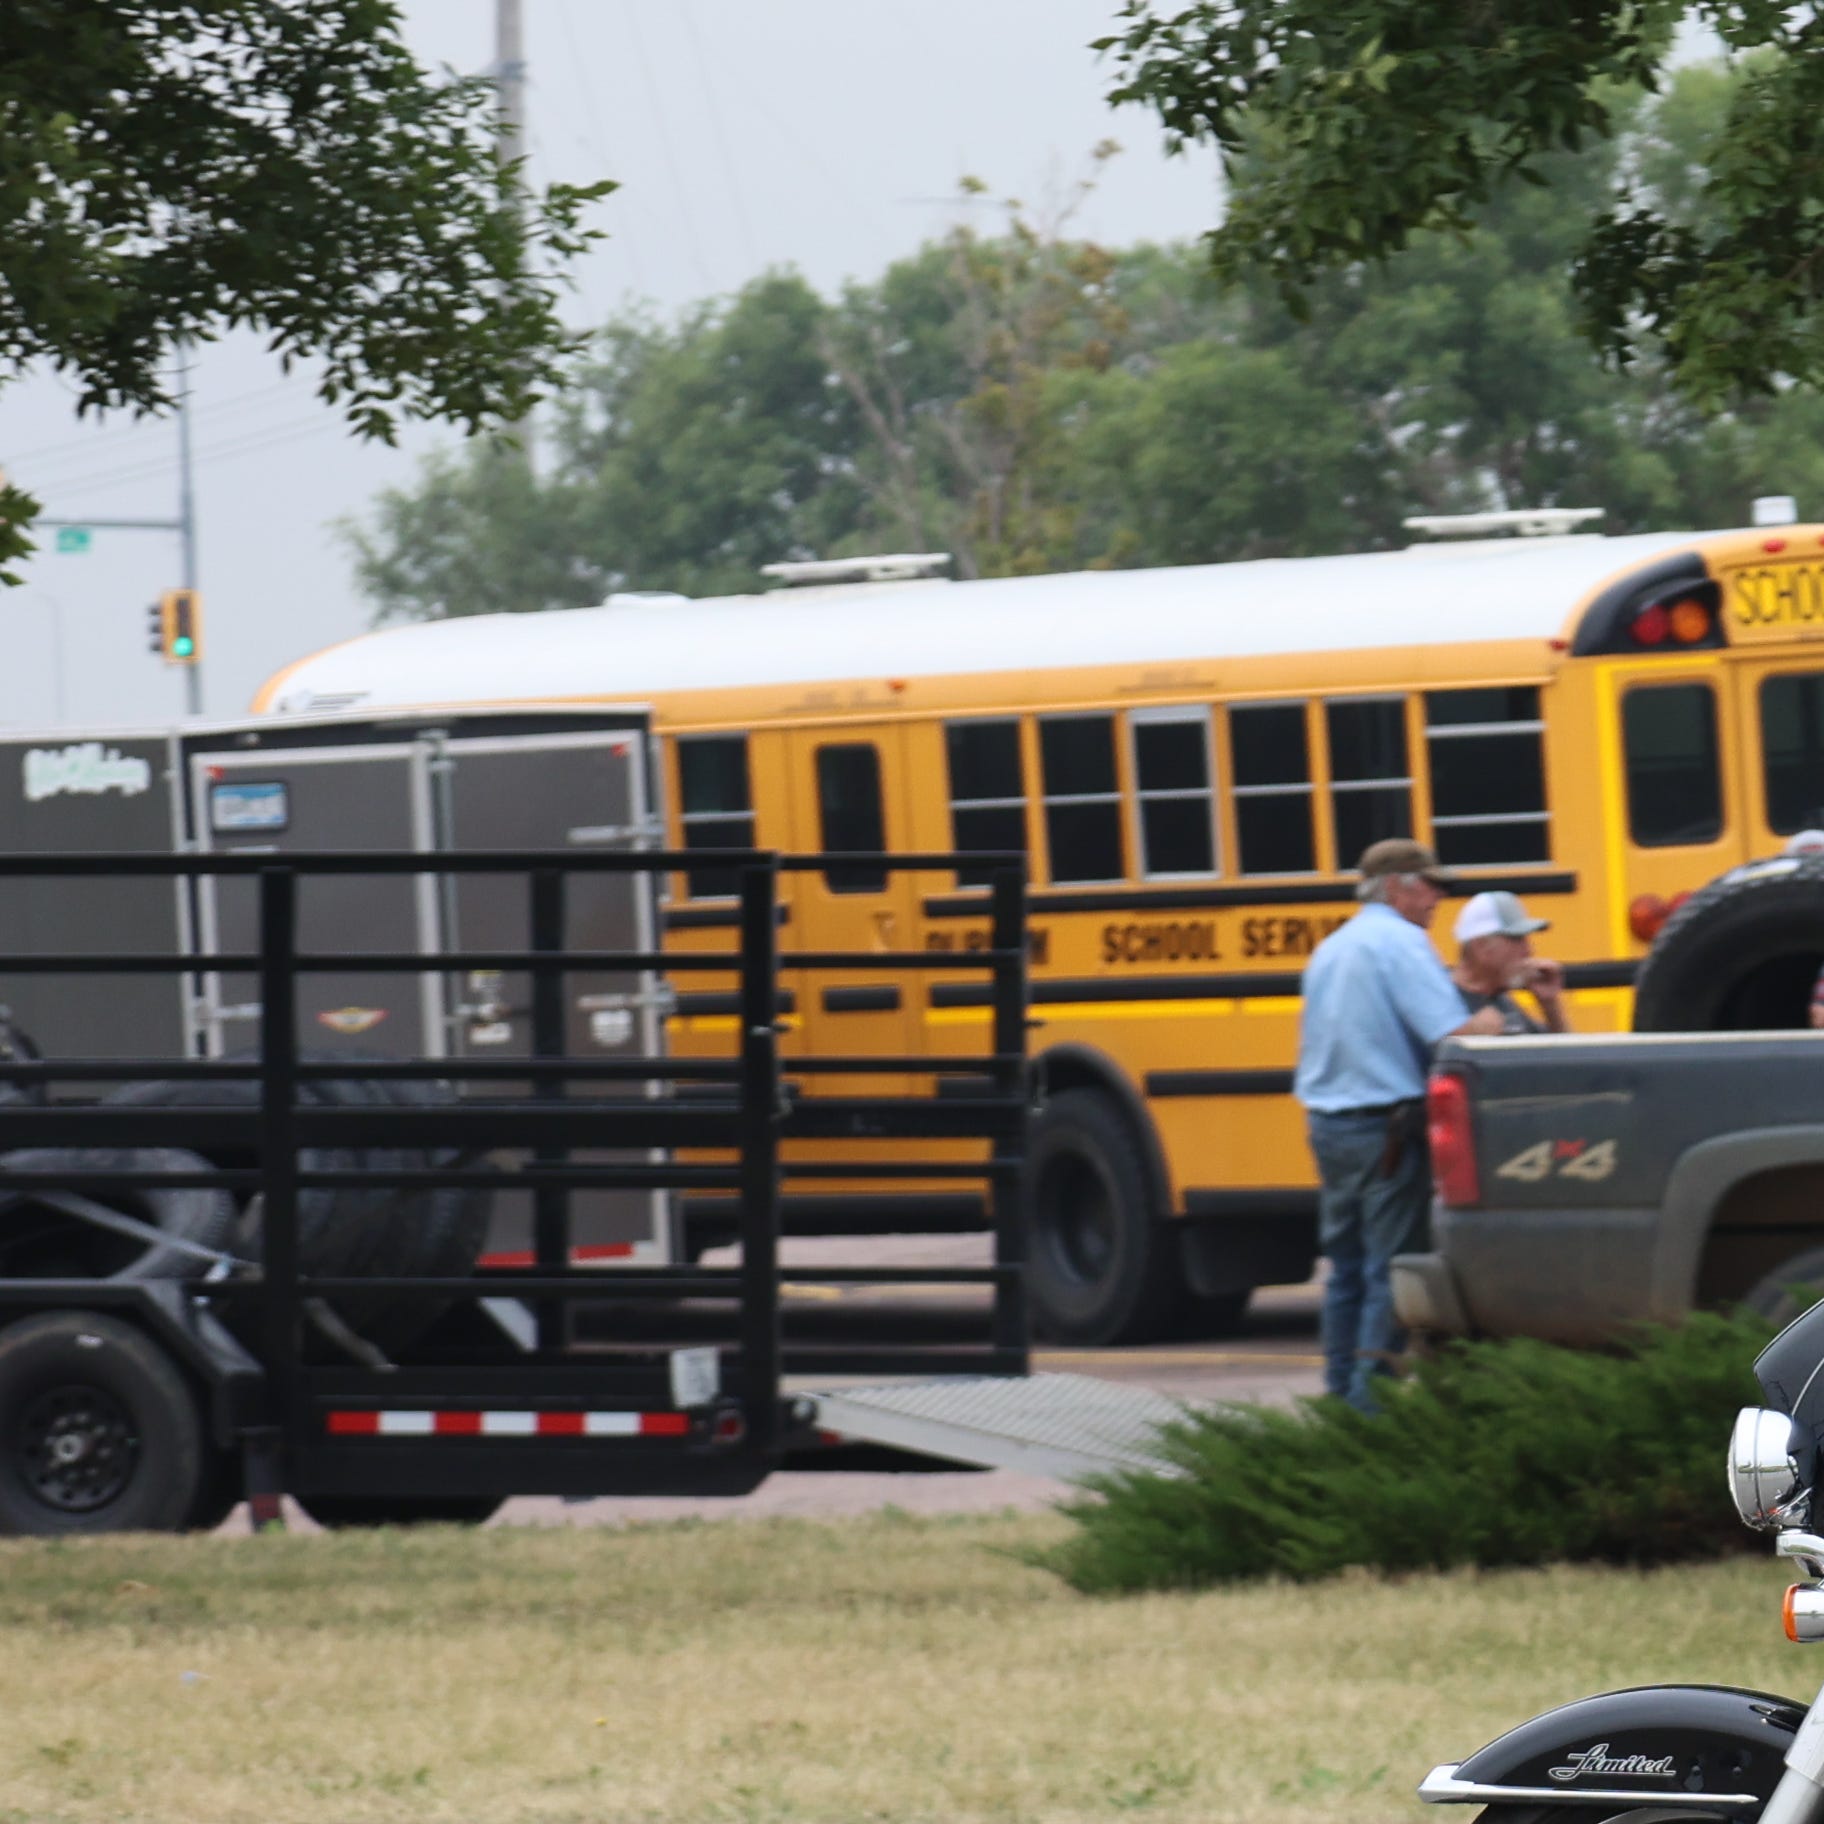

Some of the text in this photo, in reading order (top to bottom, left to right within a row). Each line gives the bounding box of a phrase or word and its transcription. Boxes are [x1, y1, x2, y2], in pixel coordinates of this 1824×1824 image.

[1102, 919, 1222, 964] SCHOOL
[1242, 913, 1352, 958] SERVI
[1548, 1743, 1677, 1780] Limited
